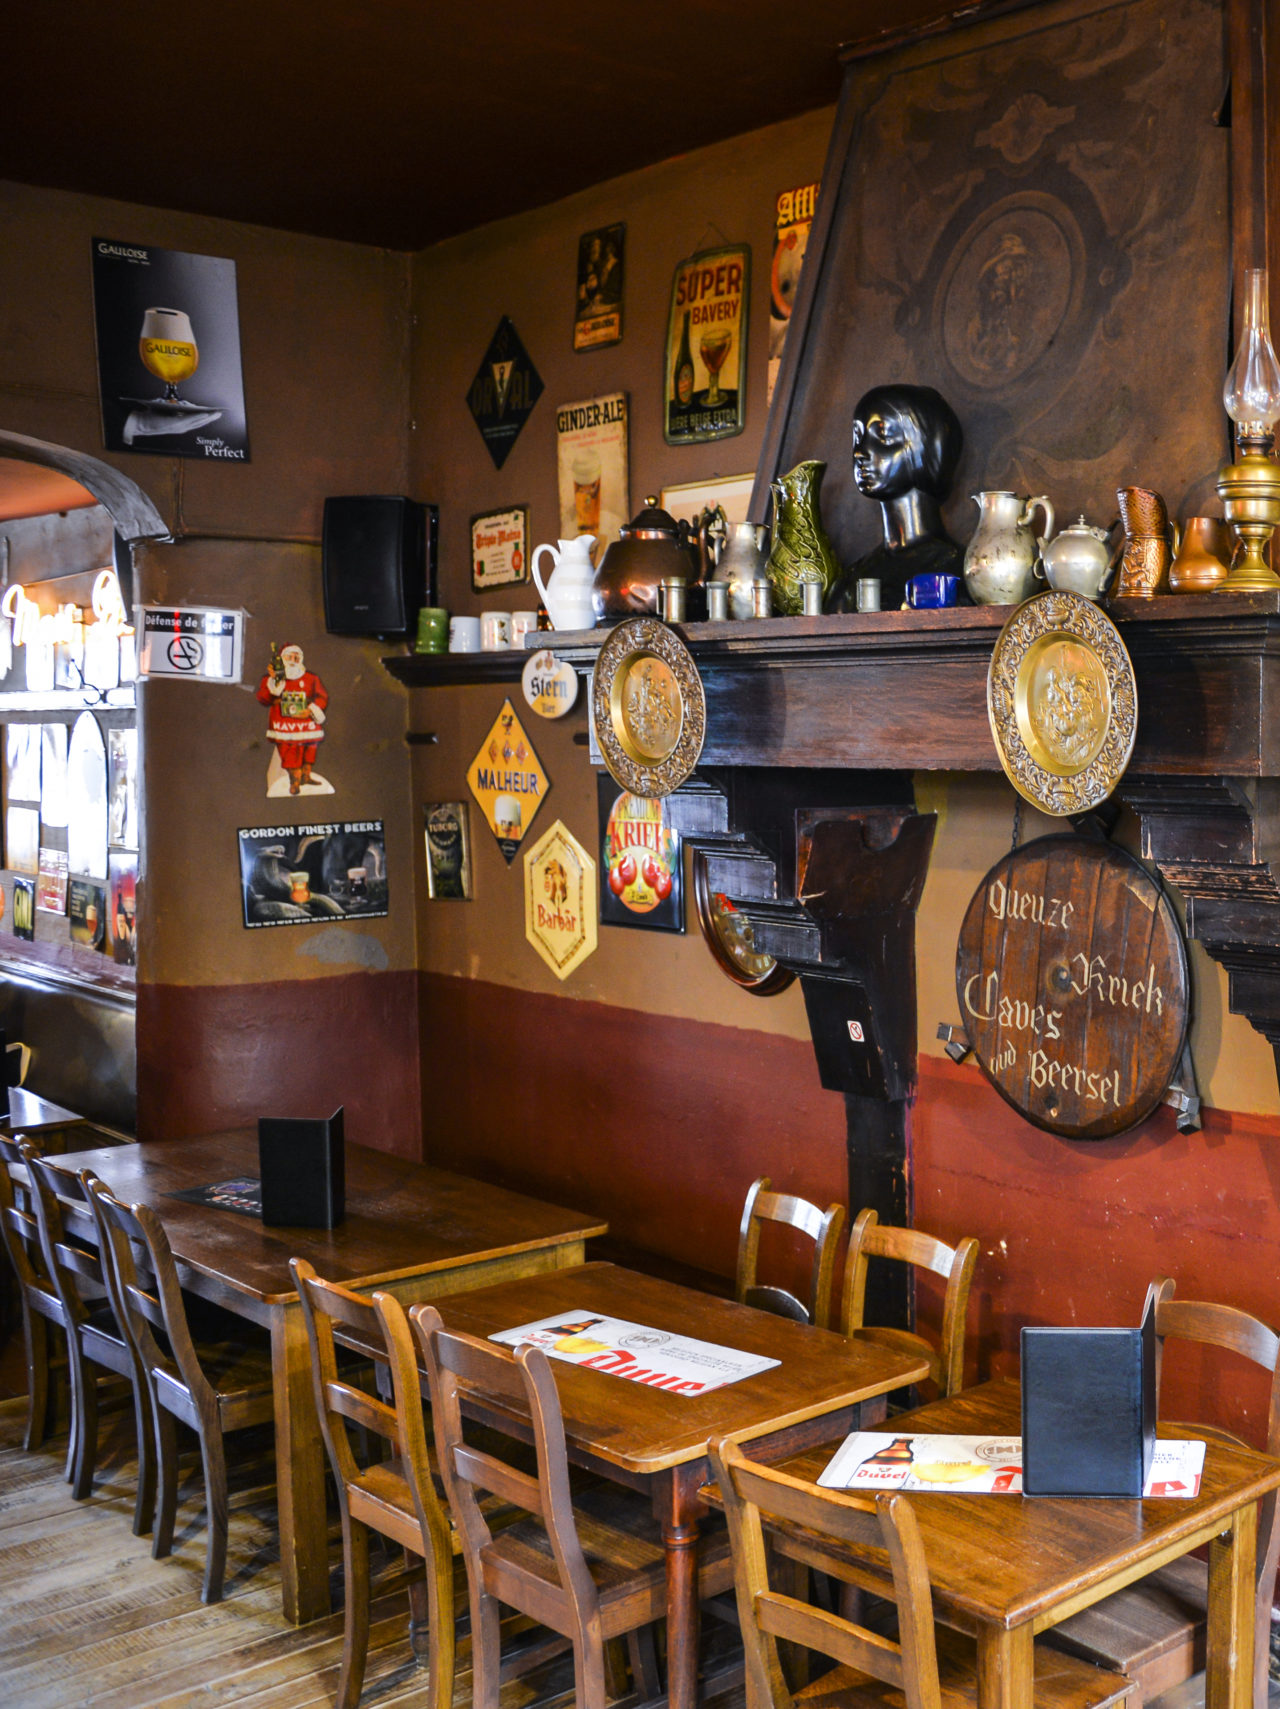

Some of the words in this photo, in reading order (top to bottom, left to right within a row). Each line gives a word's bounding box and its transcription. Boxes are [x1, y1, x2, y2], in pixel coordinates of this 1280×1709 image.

[777, 184, 820, 226] Affl
[98, 243, 149, 260] GAULOISE
[676, 263, 742, 306] SUPER
[692, 299, 739, 326] BAVERY
[145, 342, 192, 358] GAULOISE
[196, 436, 224, 448] Simply
[204, 445, 245, 460] Perfect
[145, 614, 182, 626] Défense
[184, 616, 198, 628] de
[201, 618, 234, 630] fer
[531, 676, 567, 698] Stern
[477, 767, 541, 796] MALHEUR
[240, 826, 295, 839] GORDON
[298, 824, 341, 836] FINEST
[344, 822, 382, 833] BEERS
[1070, 952, 1163, 1017] Kriek
[964, 970, 1063, 1040] Caves
[1028, 1048, 1121, 1108] Beersel
[856, 1467, 906, 1480] Duvel
